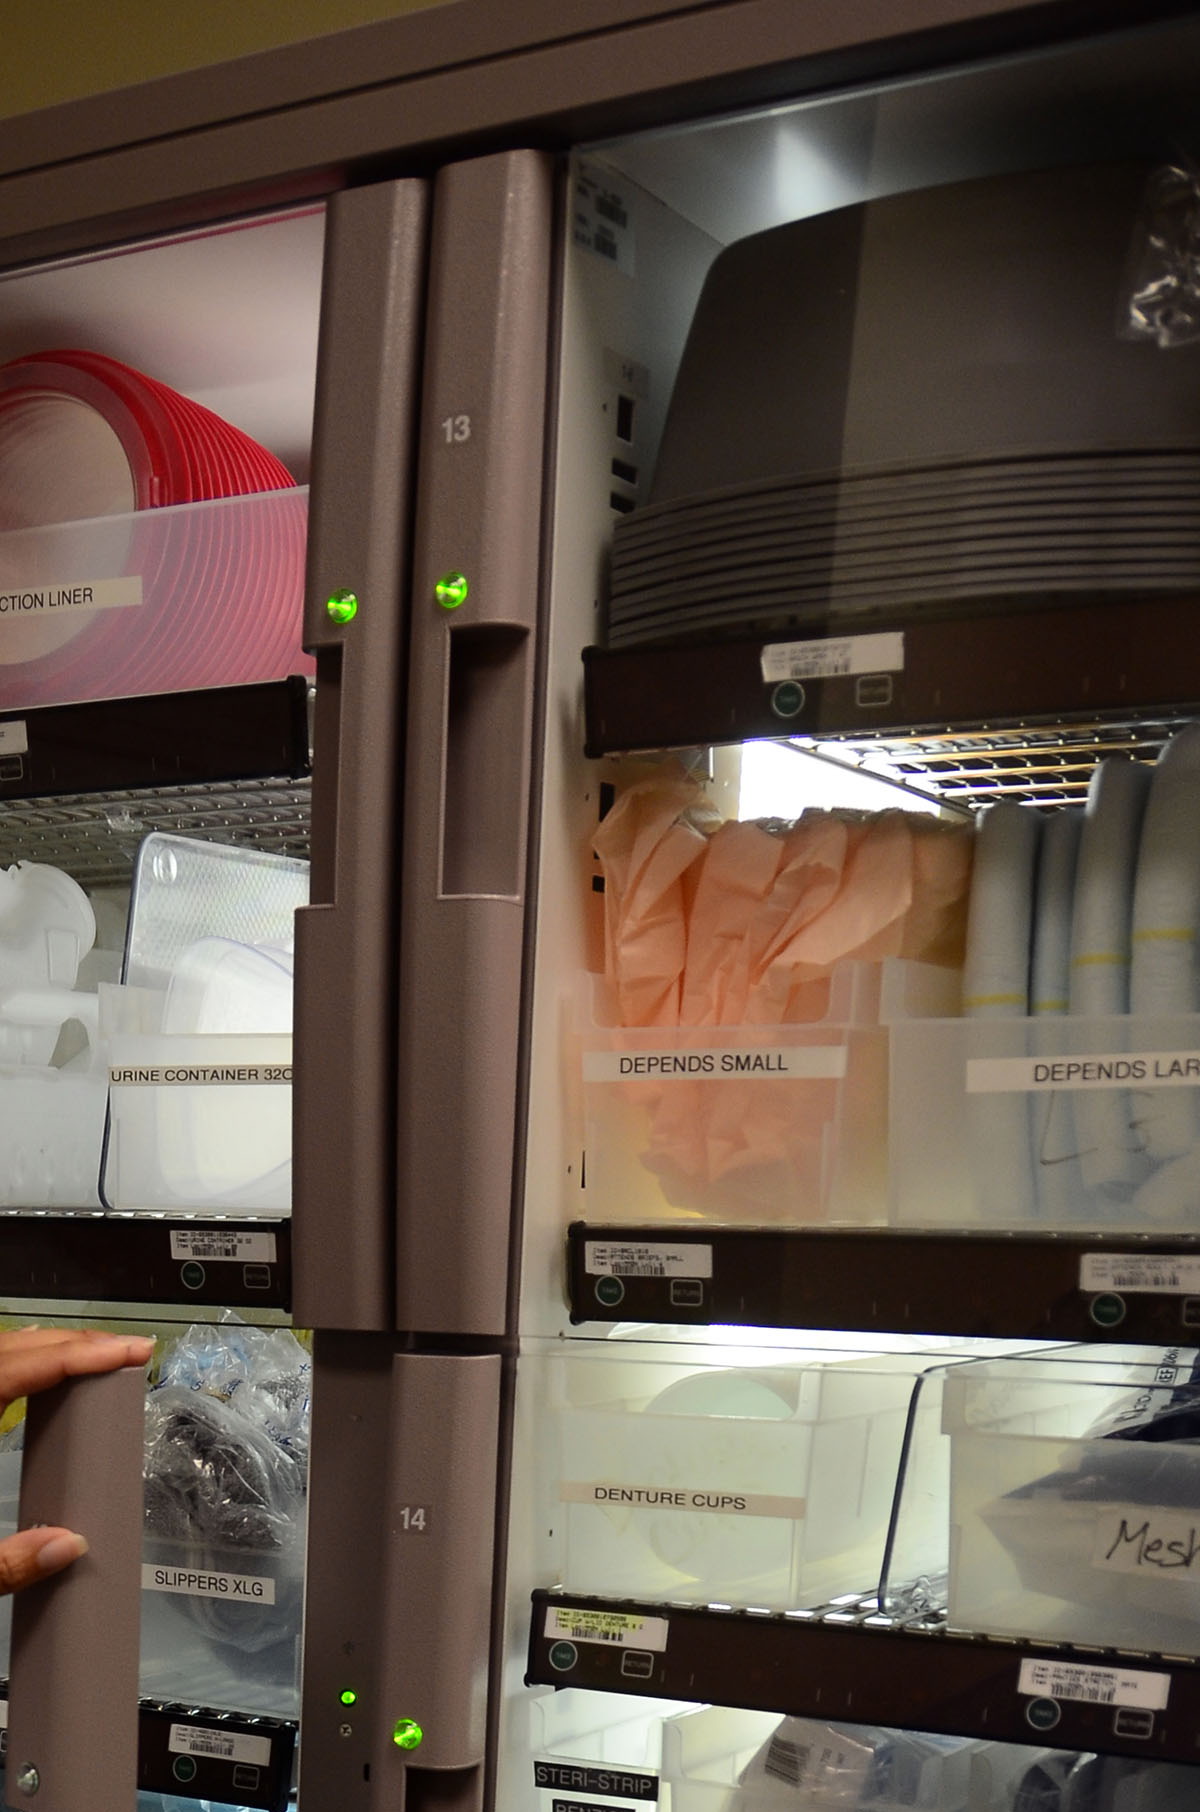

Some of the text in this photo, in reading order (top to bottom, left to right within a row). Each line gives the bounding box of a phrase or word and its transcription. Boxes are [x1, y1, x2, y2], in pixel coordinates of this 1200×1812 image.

[442, 415, 471, 443] 13
[49, 587, 94, 607] LINER
[110, 1069, 160, 1082] URINE
[164, 1068, 259, 1082] CONTAINER
[619, 1054, 789, 1074] DEPENDS SMALL
[1034, 1060, 1147, 1083] DEPENDS
[594, 1486, 747, 1510] DENTURE CUPS
[400, 1507, 426, 1530] 14
[154, 1569, 263, 1597] SLIPPERS XLG
[536, 1766, 653, 1794] STERI-STRIP
